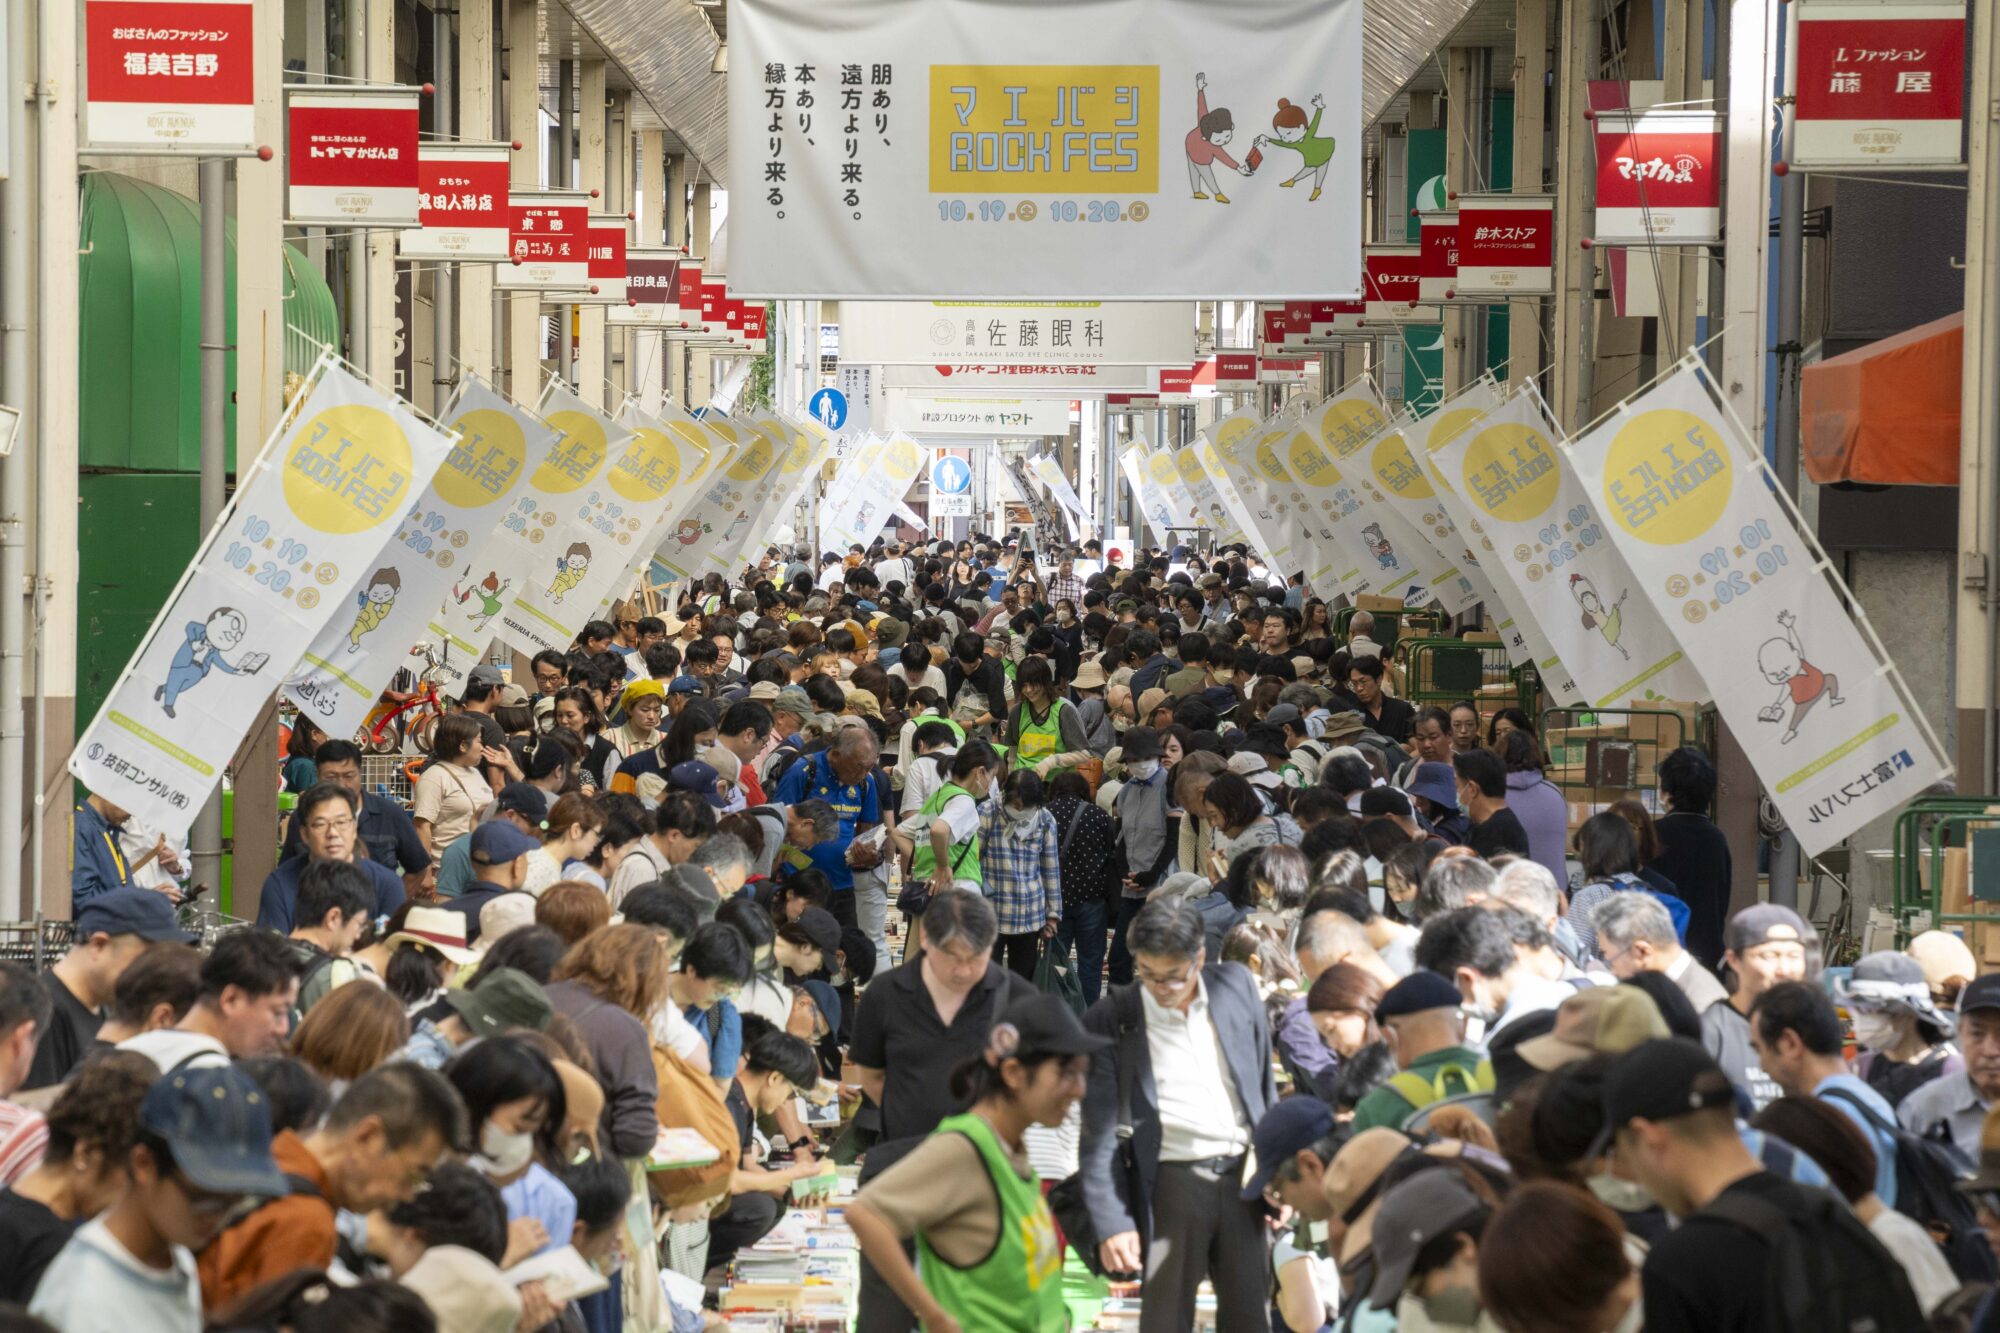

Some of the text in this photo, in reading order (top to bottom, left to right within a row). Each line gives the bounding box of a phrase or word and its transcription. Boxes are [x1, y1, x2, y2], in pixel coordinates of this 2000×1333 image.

[112, 28, 229, 41] おばさんのファッション
[124, 52, 218, 77] 福美吉野
[1836, 48, 1927, 63] L ファッション
[794, 63, 816, 146] 本あり、
[871, 64, 892, 146] 朋あり、
[950, 86, 1139, 126] マエバシ
[310, 146, 399, 160] トヤマかばん店
[765, 62, 786, 220] 縁方より来る。
[841, 63, 863, 221] 遠方より来る。
[1063, 132, 1139, 172] FES
[439, 178, 470, 186] おもちゃ
[1474, 226, 1537, 241] 鈴木ストア
[588, 247, 613, 260] 川屋
[987, 318, 1104, 347] 佐藤眼科
[922, 413, 1033, 426] 建設プロダクト ヤマト
[310, 421, 405, 498] マエバシ
[340, 477, 389, 519] FES
[101, 752, 191, 810] 技研コンサル(株)
